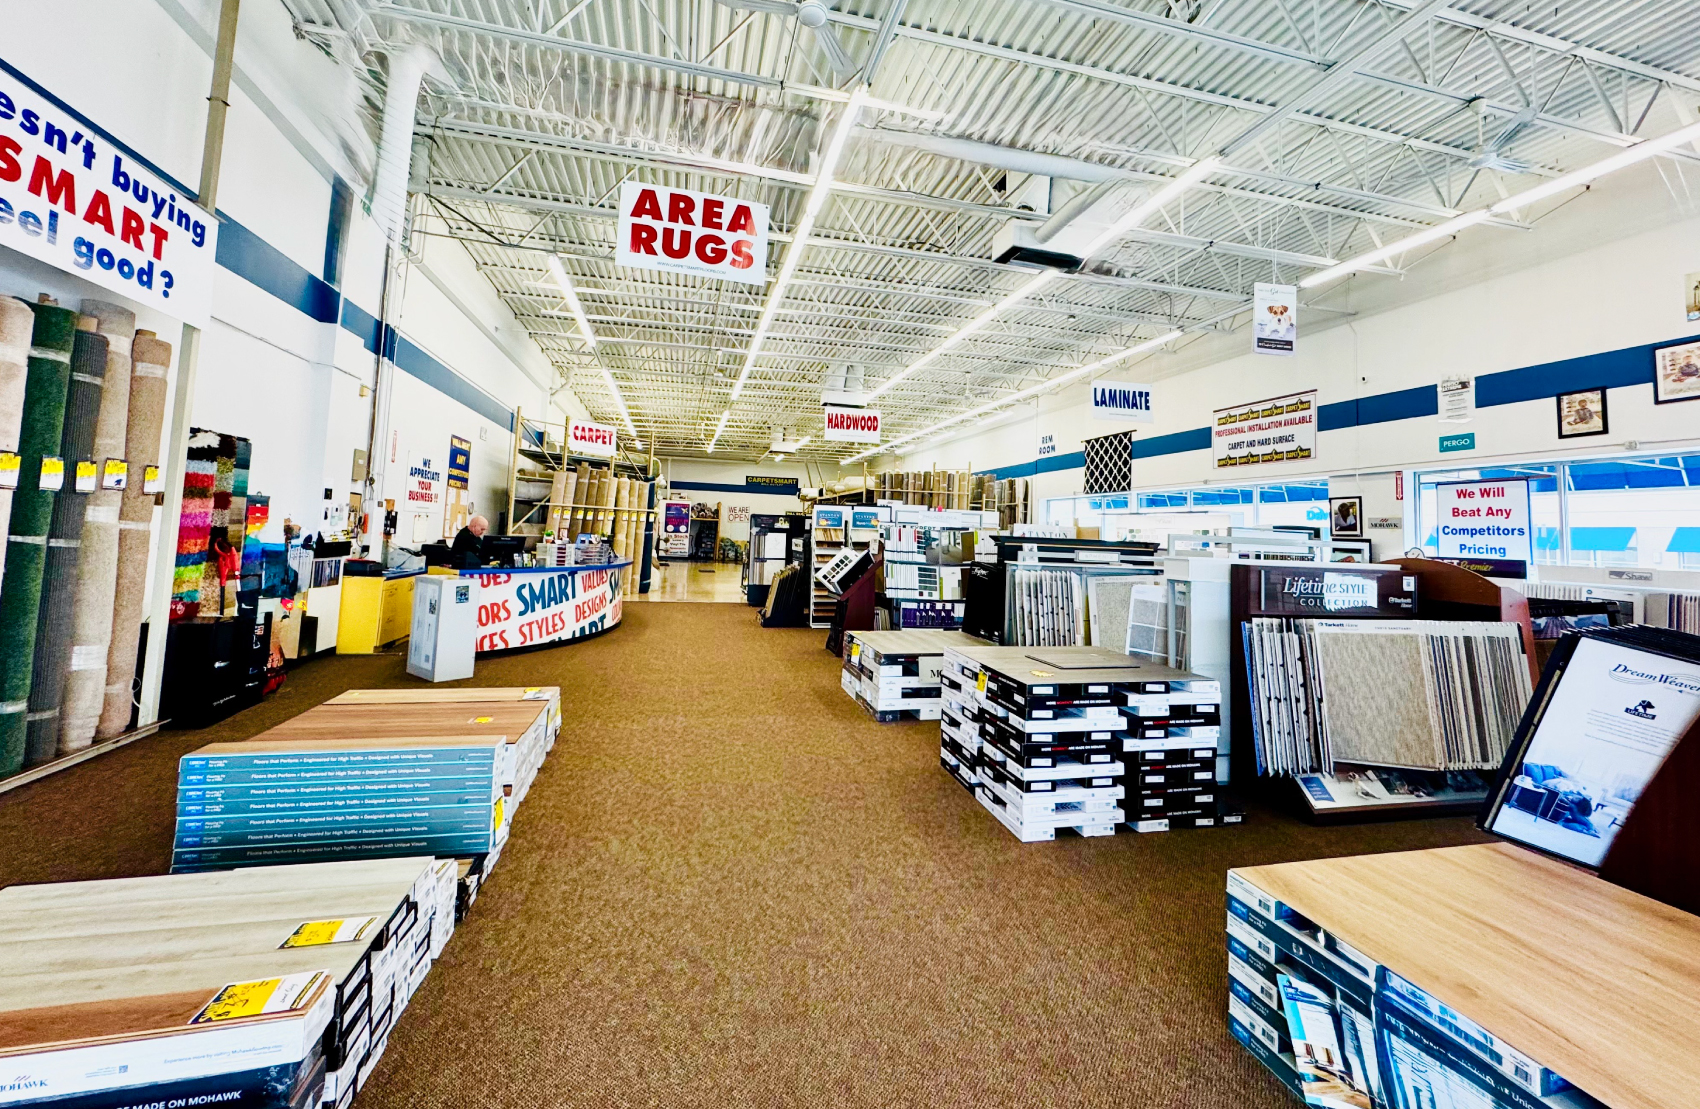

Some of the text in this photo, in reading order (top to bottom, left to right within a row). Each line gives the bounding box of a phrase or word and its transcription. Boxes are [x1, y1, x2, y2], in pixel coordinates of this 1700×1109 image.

[0, 134, 169, 261] SMART
[111, 154, 206, 248] buying
[630, 188, 758, 237] AREA
[629, 222, 755, 270] RUGS
[73, 235, 174, 299] good?
[1093, 387, 1151, 411] LAMINATE
[827, 412, 879, 432] HARDWOOD
[1215, 415, 1312, 438] PROFESSIONAL INSTALLATION AVAILABLE
[573, 425, 614, 446] CARPET
[1041, 434, 1053, 444] REM
[1228, 434, 1295, 450] CARPET AND HARD SURFACE
[1443, 438, 1470, 448] PERGO
[1039, 444, 1056, 455] ROOM
[422, 457, 431, 469] WE
[409, 466, 440, 482] APPRECIATE
[747, 476, 797, 485] CARPETSMART
[417, 480, 432, 491] YOUR
[1456, 486, 1505, 499] We Will
[408, 490, 433, 503] BUSINESS
[728, 514, 749, 522] OPEN
[1451, 506, 1512, 519] Beat Any
[1441, 525, 1525, 539] Competitors
[1459, 543, 1507, 558] Pricing
[581, 569, 608, 594] VALUES
[1283, 577, 1368, 597] Lifetime STYLE
[516, 570, 578, 617] SMART
[1300, 598, 1368, 606] COLLECTION
[477, 599, 511, 627] ORS
[575, 590, 607, 623] DESIGNS
[518, 610, 566, 646] STYLES
[475, 629, 509, 651] CES
[167, 1098, 186, 1109] ON
[187, 1090, 243, 1106] MOHAWK
